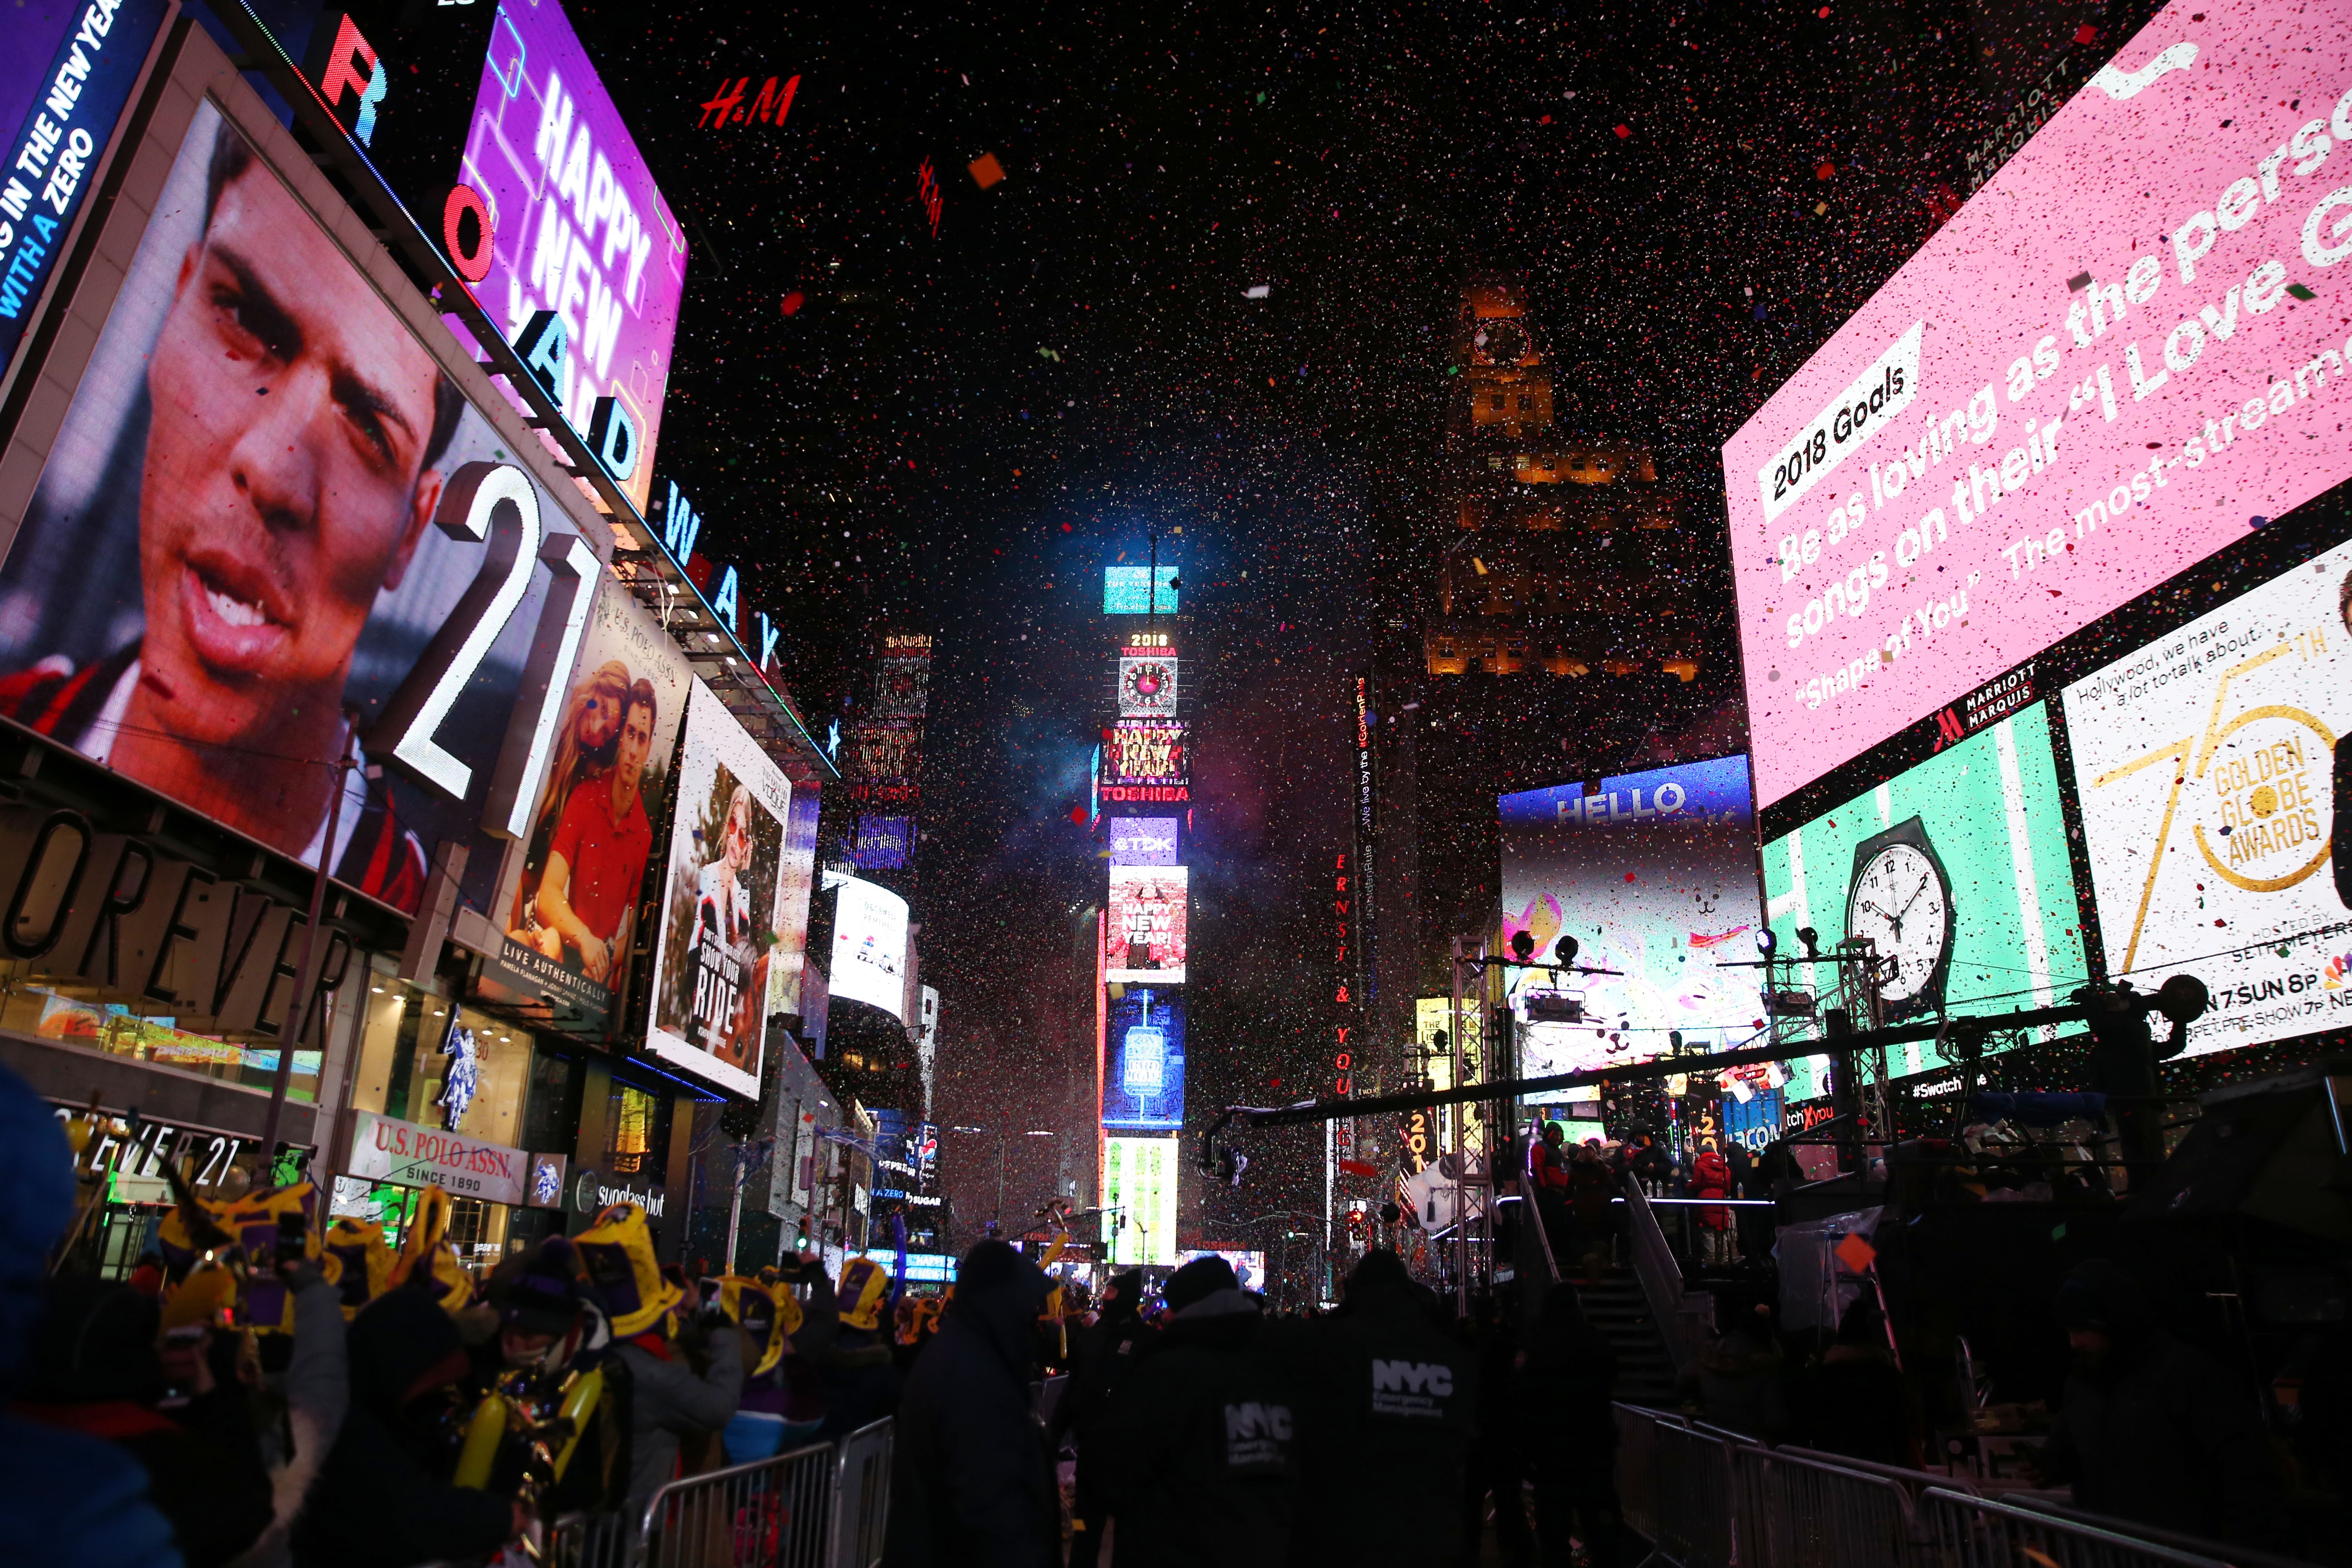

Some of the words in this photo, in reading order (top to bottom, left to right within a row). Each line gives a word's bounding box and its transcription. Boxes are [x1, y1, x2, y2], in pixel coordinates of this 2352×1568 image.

[46, 42, 91, 122] NEW
[698, 74, 801, 130] H&M
[1967, 56, 2068, 171] MARRIOTT
[16, 112, 62, 179] THE
[42, 128, 93, 215] ZERO
[536, 73, 652, 307] HAPPY
[0, 176, 33, 221] IN
[917, 154, 943, 239] H&M
[33, 214, 59, 243] A
[0, 235, 45, 318] WITH
[531, 196, 623, 381] NEW
[1774, 430, 1826, 501] 2018
[1833, 366, 1904, 444] Goals
[1779, 529, 1821, 584] Be
[1828, 492, 1866, 545] as
[1869, 382, 1998, 511] loving
[2006, 335, 2060, 403] as
[2065, 255, 2161, 349] the
[1787, 550, 1889, 648] songs
[1894, 508, 1947, 568] on
[1951, 416, 2063, 525] their
[2125, 260, 2288, 403] Love
[1885, 614, 1911, 660] of
[2002, 526, 2066, 580] The
[393, 465, 602, 839] 21
[630, 627, 655, 660] POLO
[1121, 647, 1177, 657] TOSHIBA
[1131, 634, 1167, 647] 2018
[2294, 626, 2328, 662] TH
[2077, 654, 2160, 704] Hollywood,
[2162, 641, 2185, 662] we
[2188, 621, 2229, 650] have
[2117, 694, 2127, 706] a
[2130, 679, 2149, 701] lot
[2154, 673, 2168, 688] to
[2171, 658, 2203, 681] talk
[1966, 663, 2036, 711] MARRIOTT
[1969, 685, 2031, 728] MARQUIS
[1113, 729, 1184, 745] HAPPY
[1122, 744, 1171, 760] NEW
[1360, 771, 1370, 785] by
[2214, 735, 2305, 798] GOLDEN
[1100, 787, 1189, 802] TOSHIBA
[1361, 786, 1369, 804] live
[1362, 806, 1370, 825] We
[1557, 782, 1686, 825] HELLO
[1128, 837, 1173, 851] TDK
[2230, 808, 2319, 867] AWARDS
[0, 779, 354, 1052] OREVER
[1122, 903, 1172, 914] HAPPY
[1122, 916, 1172, 931] NEW
[1336, 854, 1348, 961] ERNST
[2253, 918, 2309, 941] HOSTED
[2312, 911, 2330, 925] BY
[1122, 931, 1172, 944] YEAR!
[500, 959, 519, 973] PAMELA
[520, 968, 544, 985] FLANAGAN
[503, 943, 529, 965] LIVE
[533, 958, 607, 1002] AUTHENTICALLY
[700, 941, 721, 972] SHOW
[723, 956, 740, 985] YOUR
[693, 965, 737, 1034] RIDE
[1336, 986, 1349, 1003] &
[2220, 990, 2233, 1009] 7
[2237, 978, 2285, 1005] SUN
[2222, 1004, 2303, 1032] PRE-SHOW
[195, 1137, 240, 1187] 21
[376, 1122, 409, 1158] U.S.
[412, 1131, 463, 1168] POLO
[466, 1143, 512, 1180] ASSN.
[407, 1166, 446, 1186] SINCE
[451, 1176, 480, 1192] 1890
[884, 1189, 904, 1199] ZERO
[913, 1196, 941, 1206] SUGAR
[646, 1188, 665, 1218] hut
[916, 1256, 945, 1268] HAPPY
[1196, 1240, 1247, 1250] TOSHIBA
[1372, 1358, 1453, 1397] NYC
[1372, 1392, 1434, 1406] Emergency
[1372, 1401, 1443, 1418] Management
